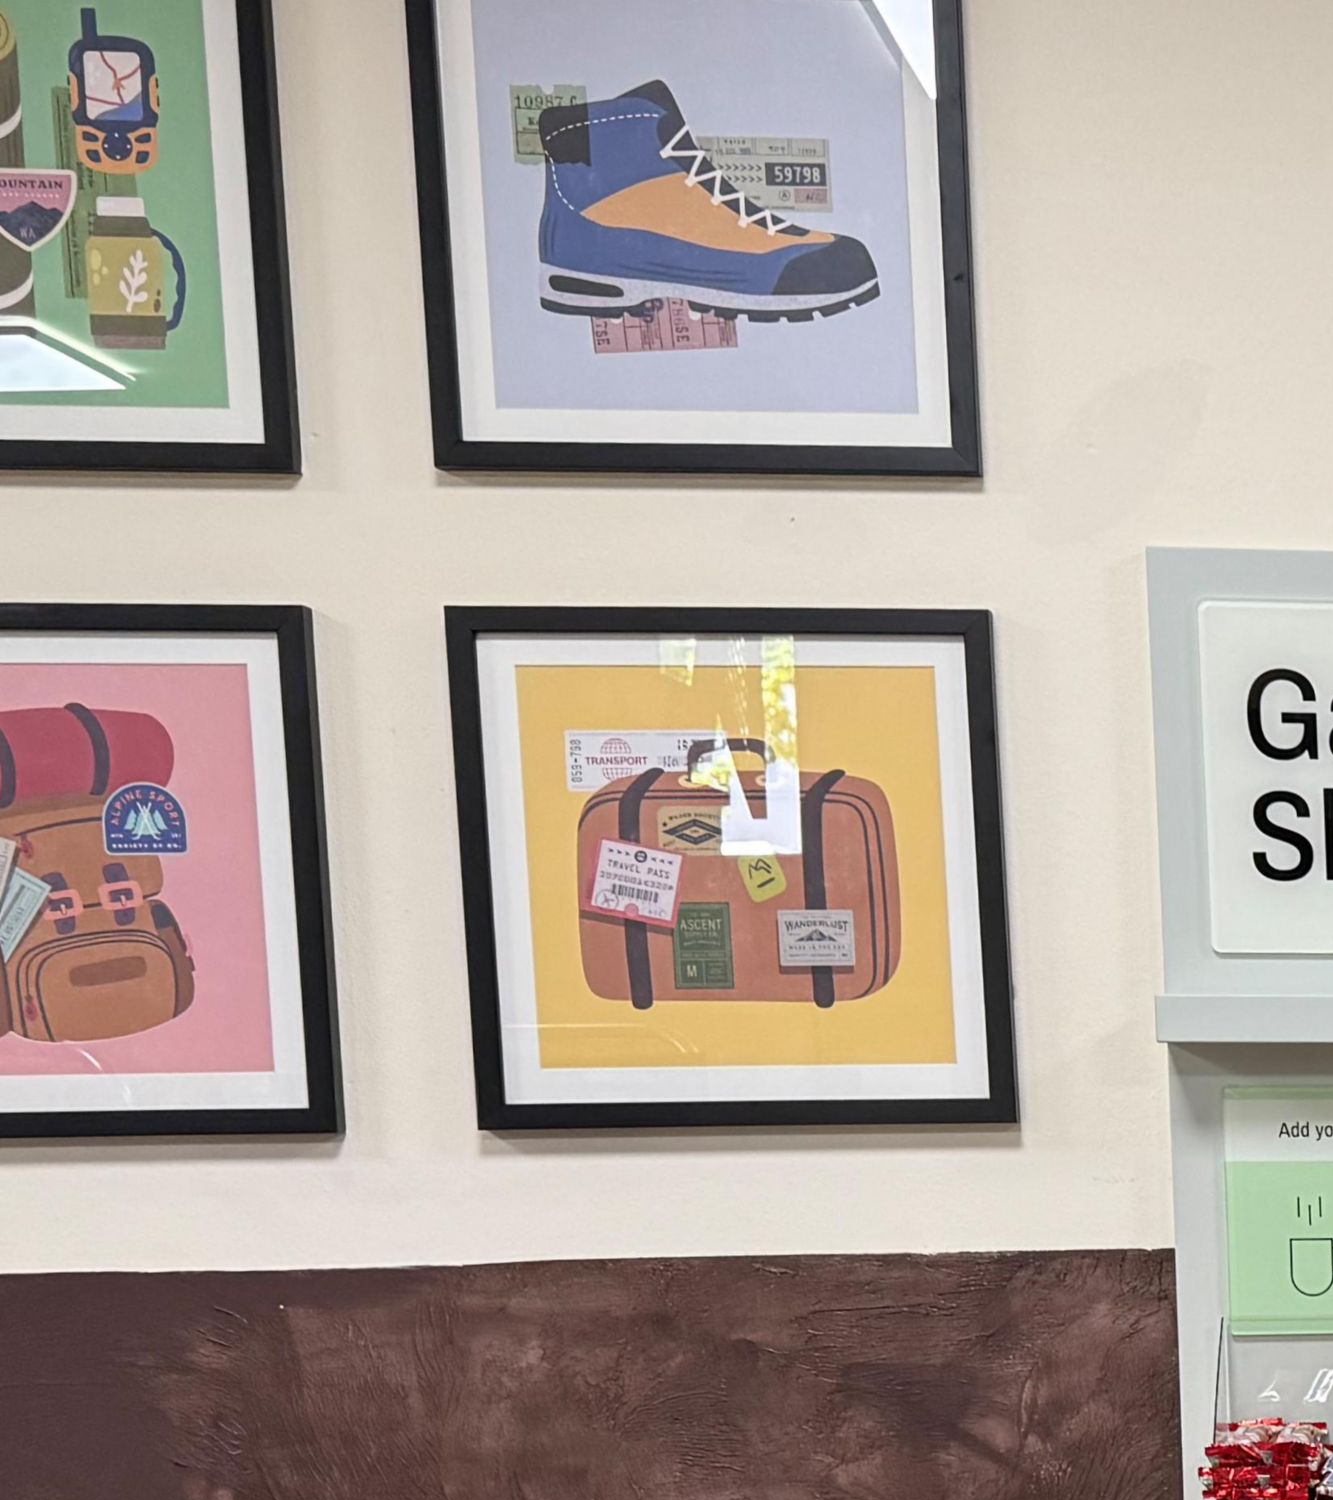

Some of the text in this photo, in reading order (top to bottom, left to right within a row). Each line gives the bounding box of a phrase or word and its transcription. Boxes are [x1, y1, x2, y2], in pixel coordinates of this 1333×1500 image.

[774, 166, 821, 183] 59798
[0, 179, 63, 189] OUNTAIN
[585, 756, 648, 766] TRANSPORT
[149, 791, 180, 827] SPORT
[680, 918, 723, 931] ASCENT
[784, 920, 849, 932] WANDERLUST
[687, 965, 697, 977] M
[1278, 1122, 1310, 1138] Add
